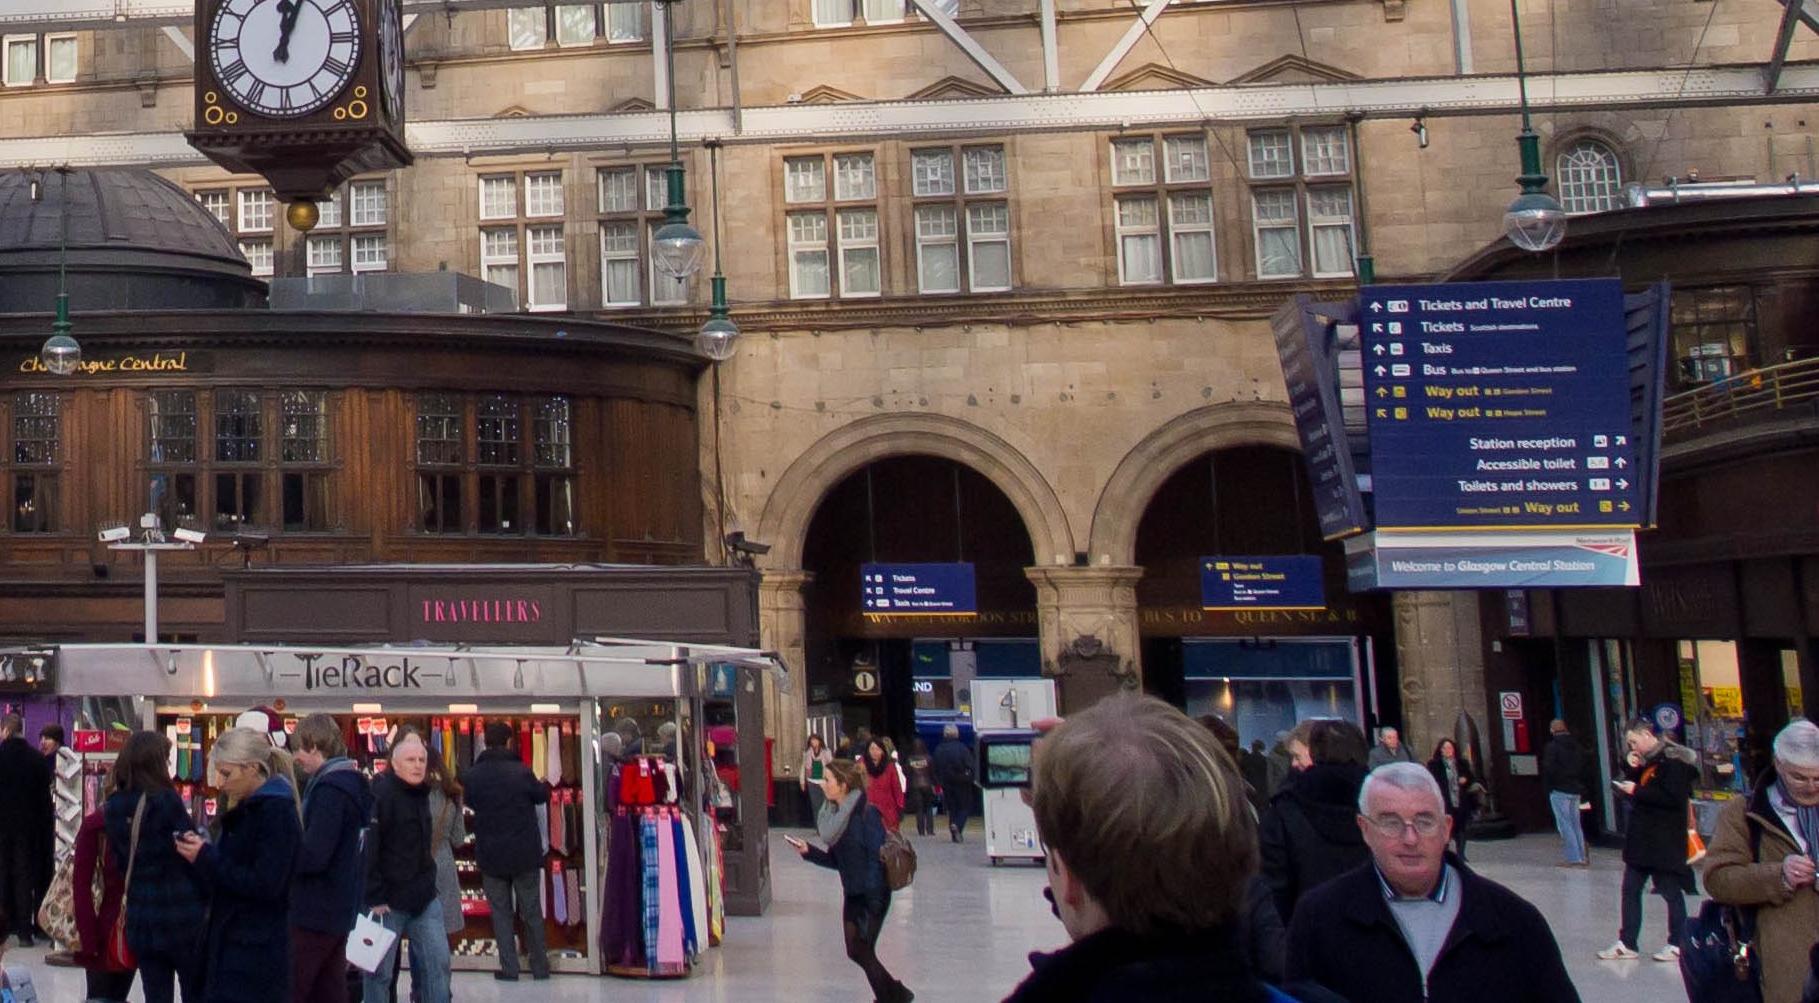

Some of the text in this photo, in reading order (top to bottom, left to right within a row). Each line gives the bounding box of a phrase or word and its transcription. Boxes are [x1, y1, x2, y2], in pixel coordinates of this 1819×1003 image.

[1419, 297, 1572, 311] Tickets and Travel Centre
[1421, 322, 1465, 333] Tickets
[1422, 342, 1453, 354] Taxis
[20, 351, 188, 375] Chaagne Central
[1424, 364, 1447, 375] Bus
[1425, 386, 1453, 399] Way
[1456, 386, 1480, 397] out
[1427, 408, 1454, 420] Way
[1458, 407, 1481, 418] out
[1469, 437, 1577, 450] Station reception
[1477, 458, 1577, 470] Accessible toilet
[1458, 480, 1578, 492] Toilets and showers
[1524, 501, 1552, 515] Way
[1556, 502, 1580, 513] out
[1392, 559, 1595, 574] Welcome to Glasgow Central Station
[892, 574, 916, 583] Tickets
[893, 587, 935, 595] Travel Centre
[422, 600, 541, 623] TRAVELLERS
[912, 682, 933, 692] ND
